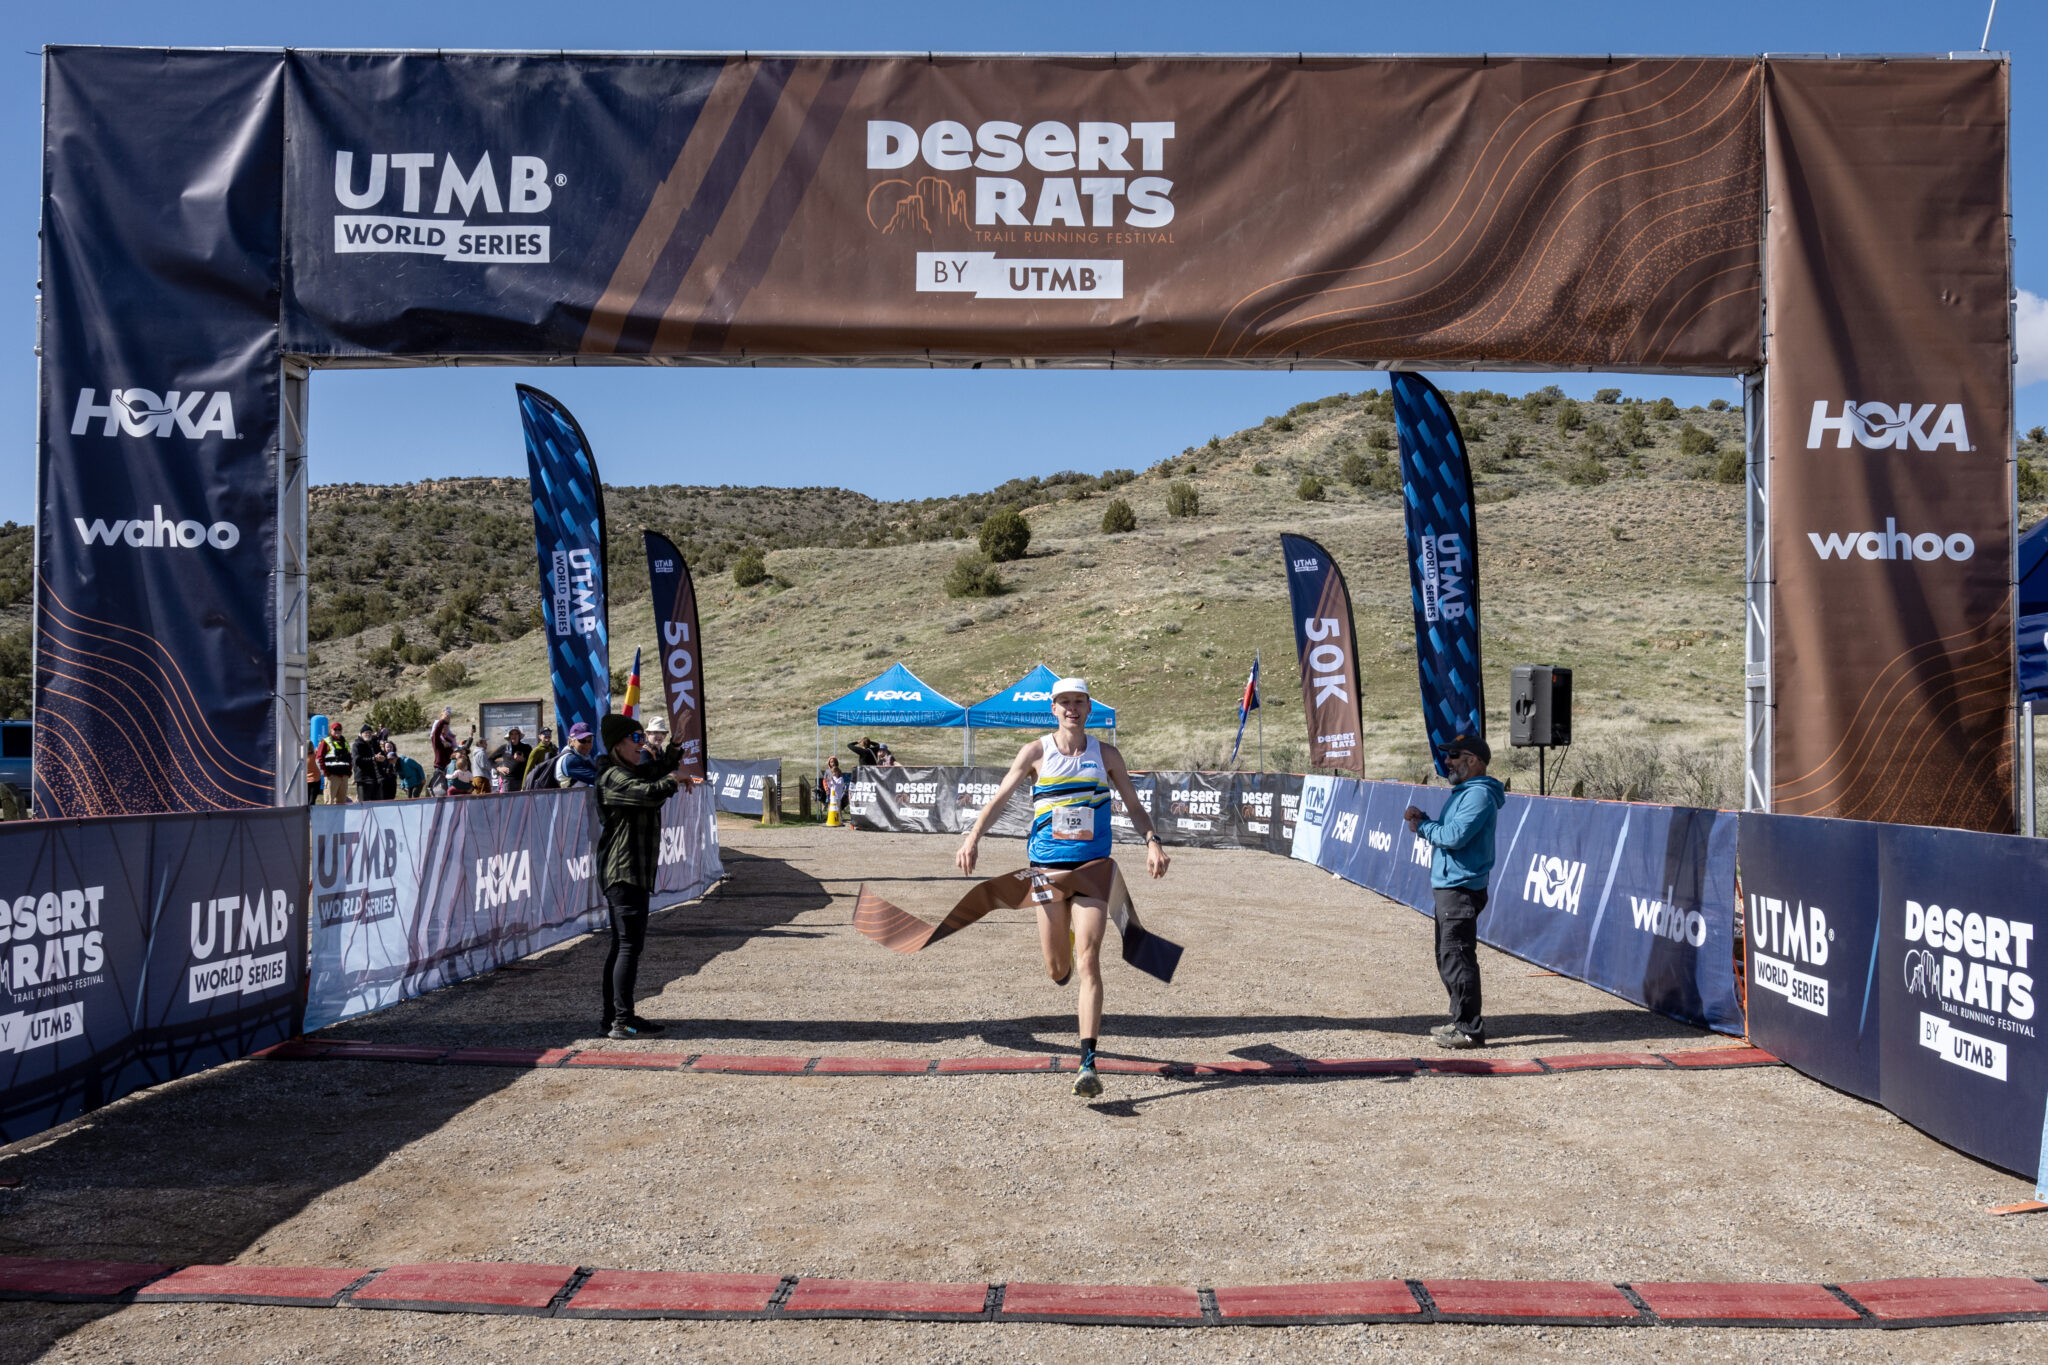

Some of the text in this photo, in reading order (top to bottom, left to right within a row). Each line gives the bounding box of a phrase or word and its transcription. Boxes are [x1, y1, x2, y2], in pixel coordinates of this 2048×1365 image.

[976, 176, 1175, 228] RATS
[343, 222, 542, 256] WORLD SERIES
[976, 231, 1175, 244] TRAIL RUNNING FESTIVAL
[934, 261, 968, 283] BY
[70, 388, 236, 439] HOKA
[1806, 400, 1970, 451] HOKA
[74, 505, 240, 550] wahoo
[1807, 517, 1975, 561] wahoo
[555, 555, 568, 632] WORLD SERIES
[1425, 540, 1436, 618] WORLD SERIES
[664, 621, 695, 715] 50K
[1305, 618, 1349, 709] 50K
[864, 690, 922, 701] HOKA
[1013, 692, 1052, 701] HOK
[836, 711, 946, 723] FLY HUMAN FLY
[985, 711, 1059, 724] FLY HUMA
[1331, 739, 1356, 748] RATS
[909, 793, 936, 804] RATS
[1189, 803, 1221, 815] RATS
[1066, 817, 1082, 826] 152
[475, 849, 531, 912] HOKA
[1523, 853, 1587, 915] HOKA
[321, 894, 395, 921] WORLD SERIES
[1630, 885, 1706, 947] wahoo
[13, 930, 104, 989] RATS
[194, 960, 284, 994] WORLD SERIES
[13, 973, 105, 1004] TRAIL RUNNING FESTIVAL
[1757, 960, 1825, 1008] WORLD SERIES
[1941, 955, 2036, 1021] RATS
[1925, 1023, 1939, 1043] BY
[1941, 1001, 2036, 1038] TRAIL RUNNING FESTIVAL
